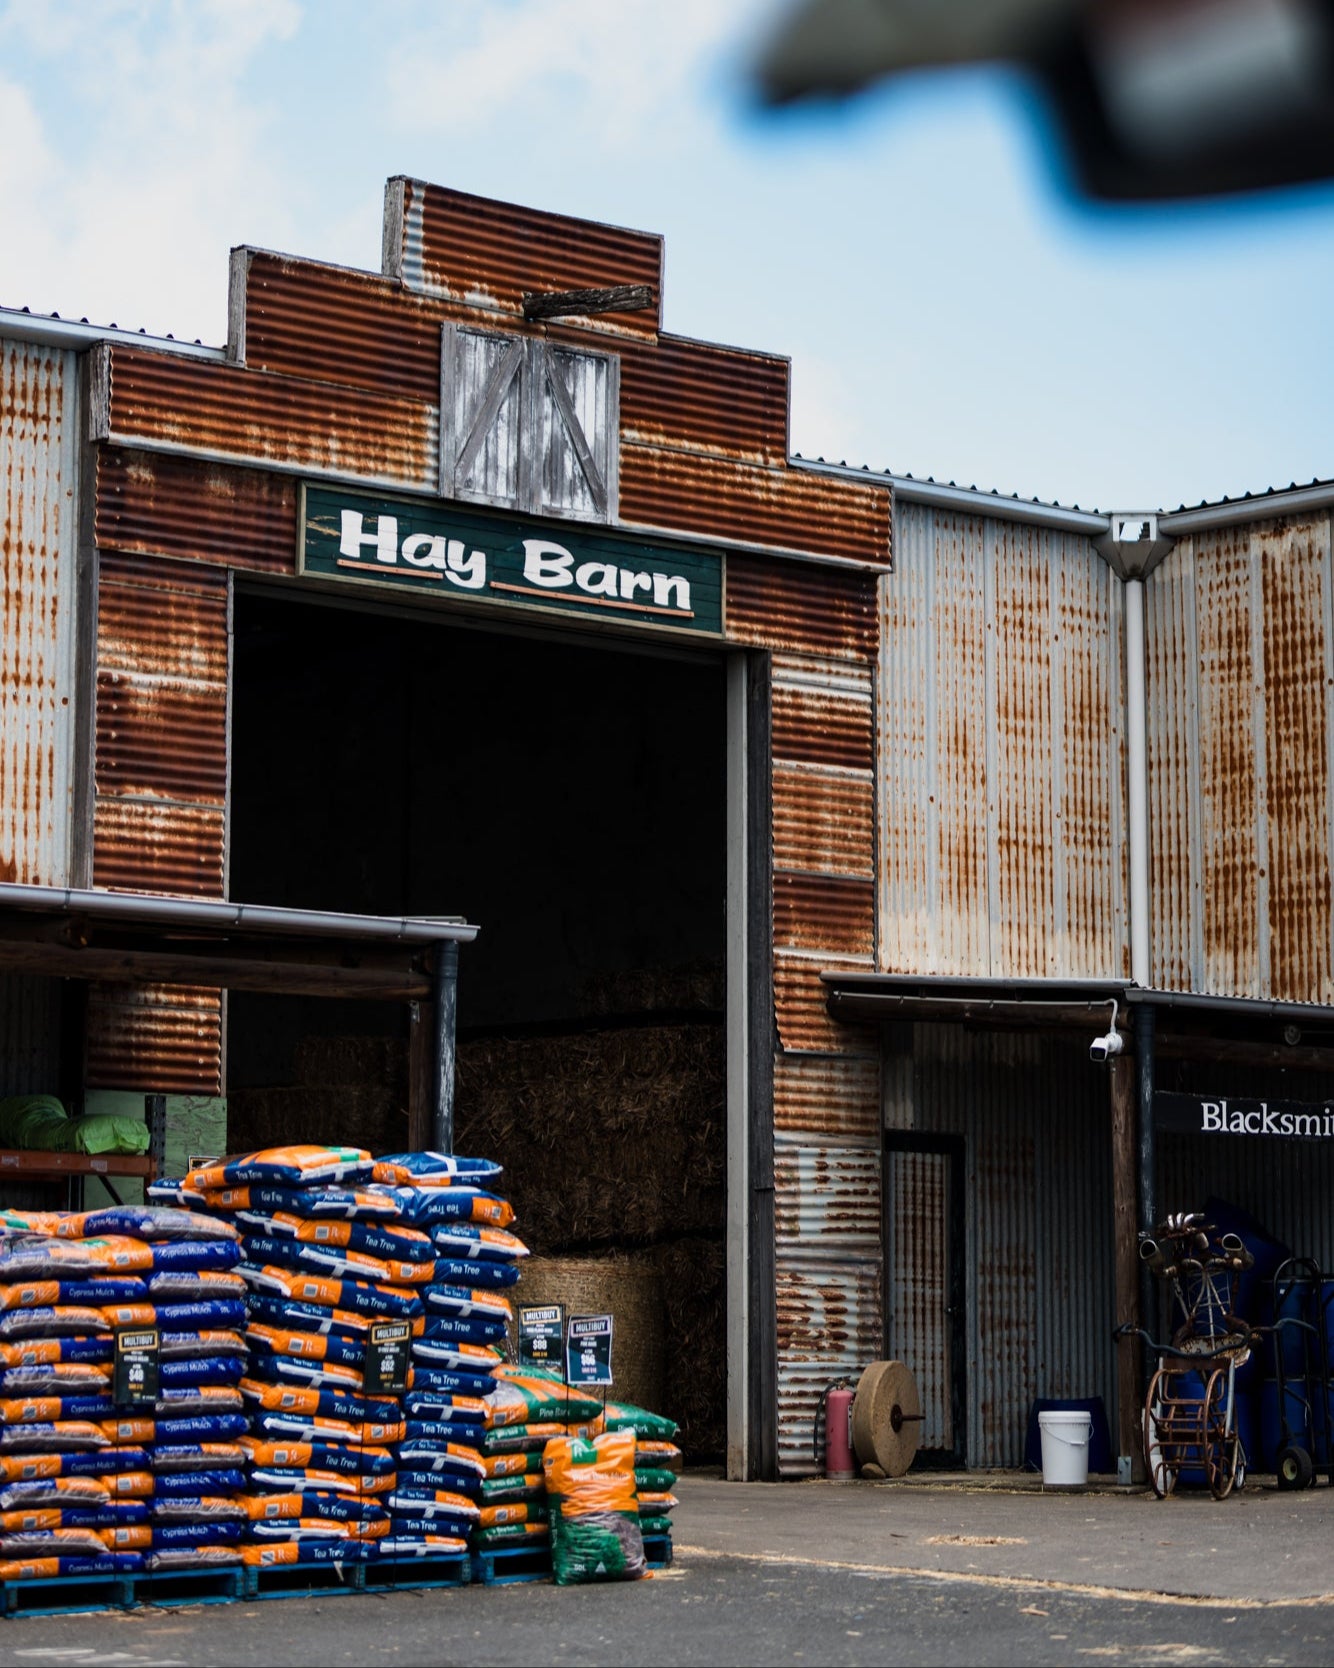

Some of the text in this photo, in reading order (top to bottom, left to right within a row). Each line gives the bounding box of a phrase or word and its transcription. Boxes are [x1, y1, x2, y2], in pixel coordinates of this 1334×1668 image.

[339, 509, 691, 610] Hay Barn
[526, 1310, 555, 1320] MULTIBUY
[576, 1322, 605, 1332] MULTIBUY
[377, 1327, 405, 1338] MULTIBUY
